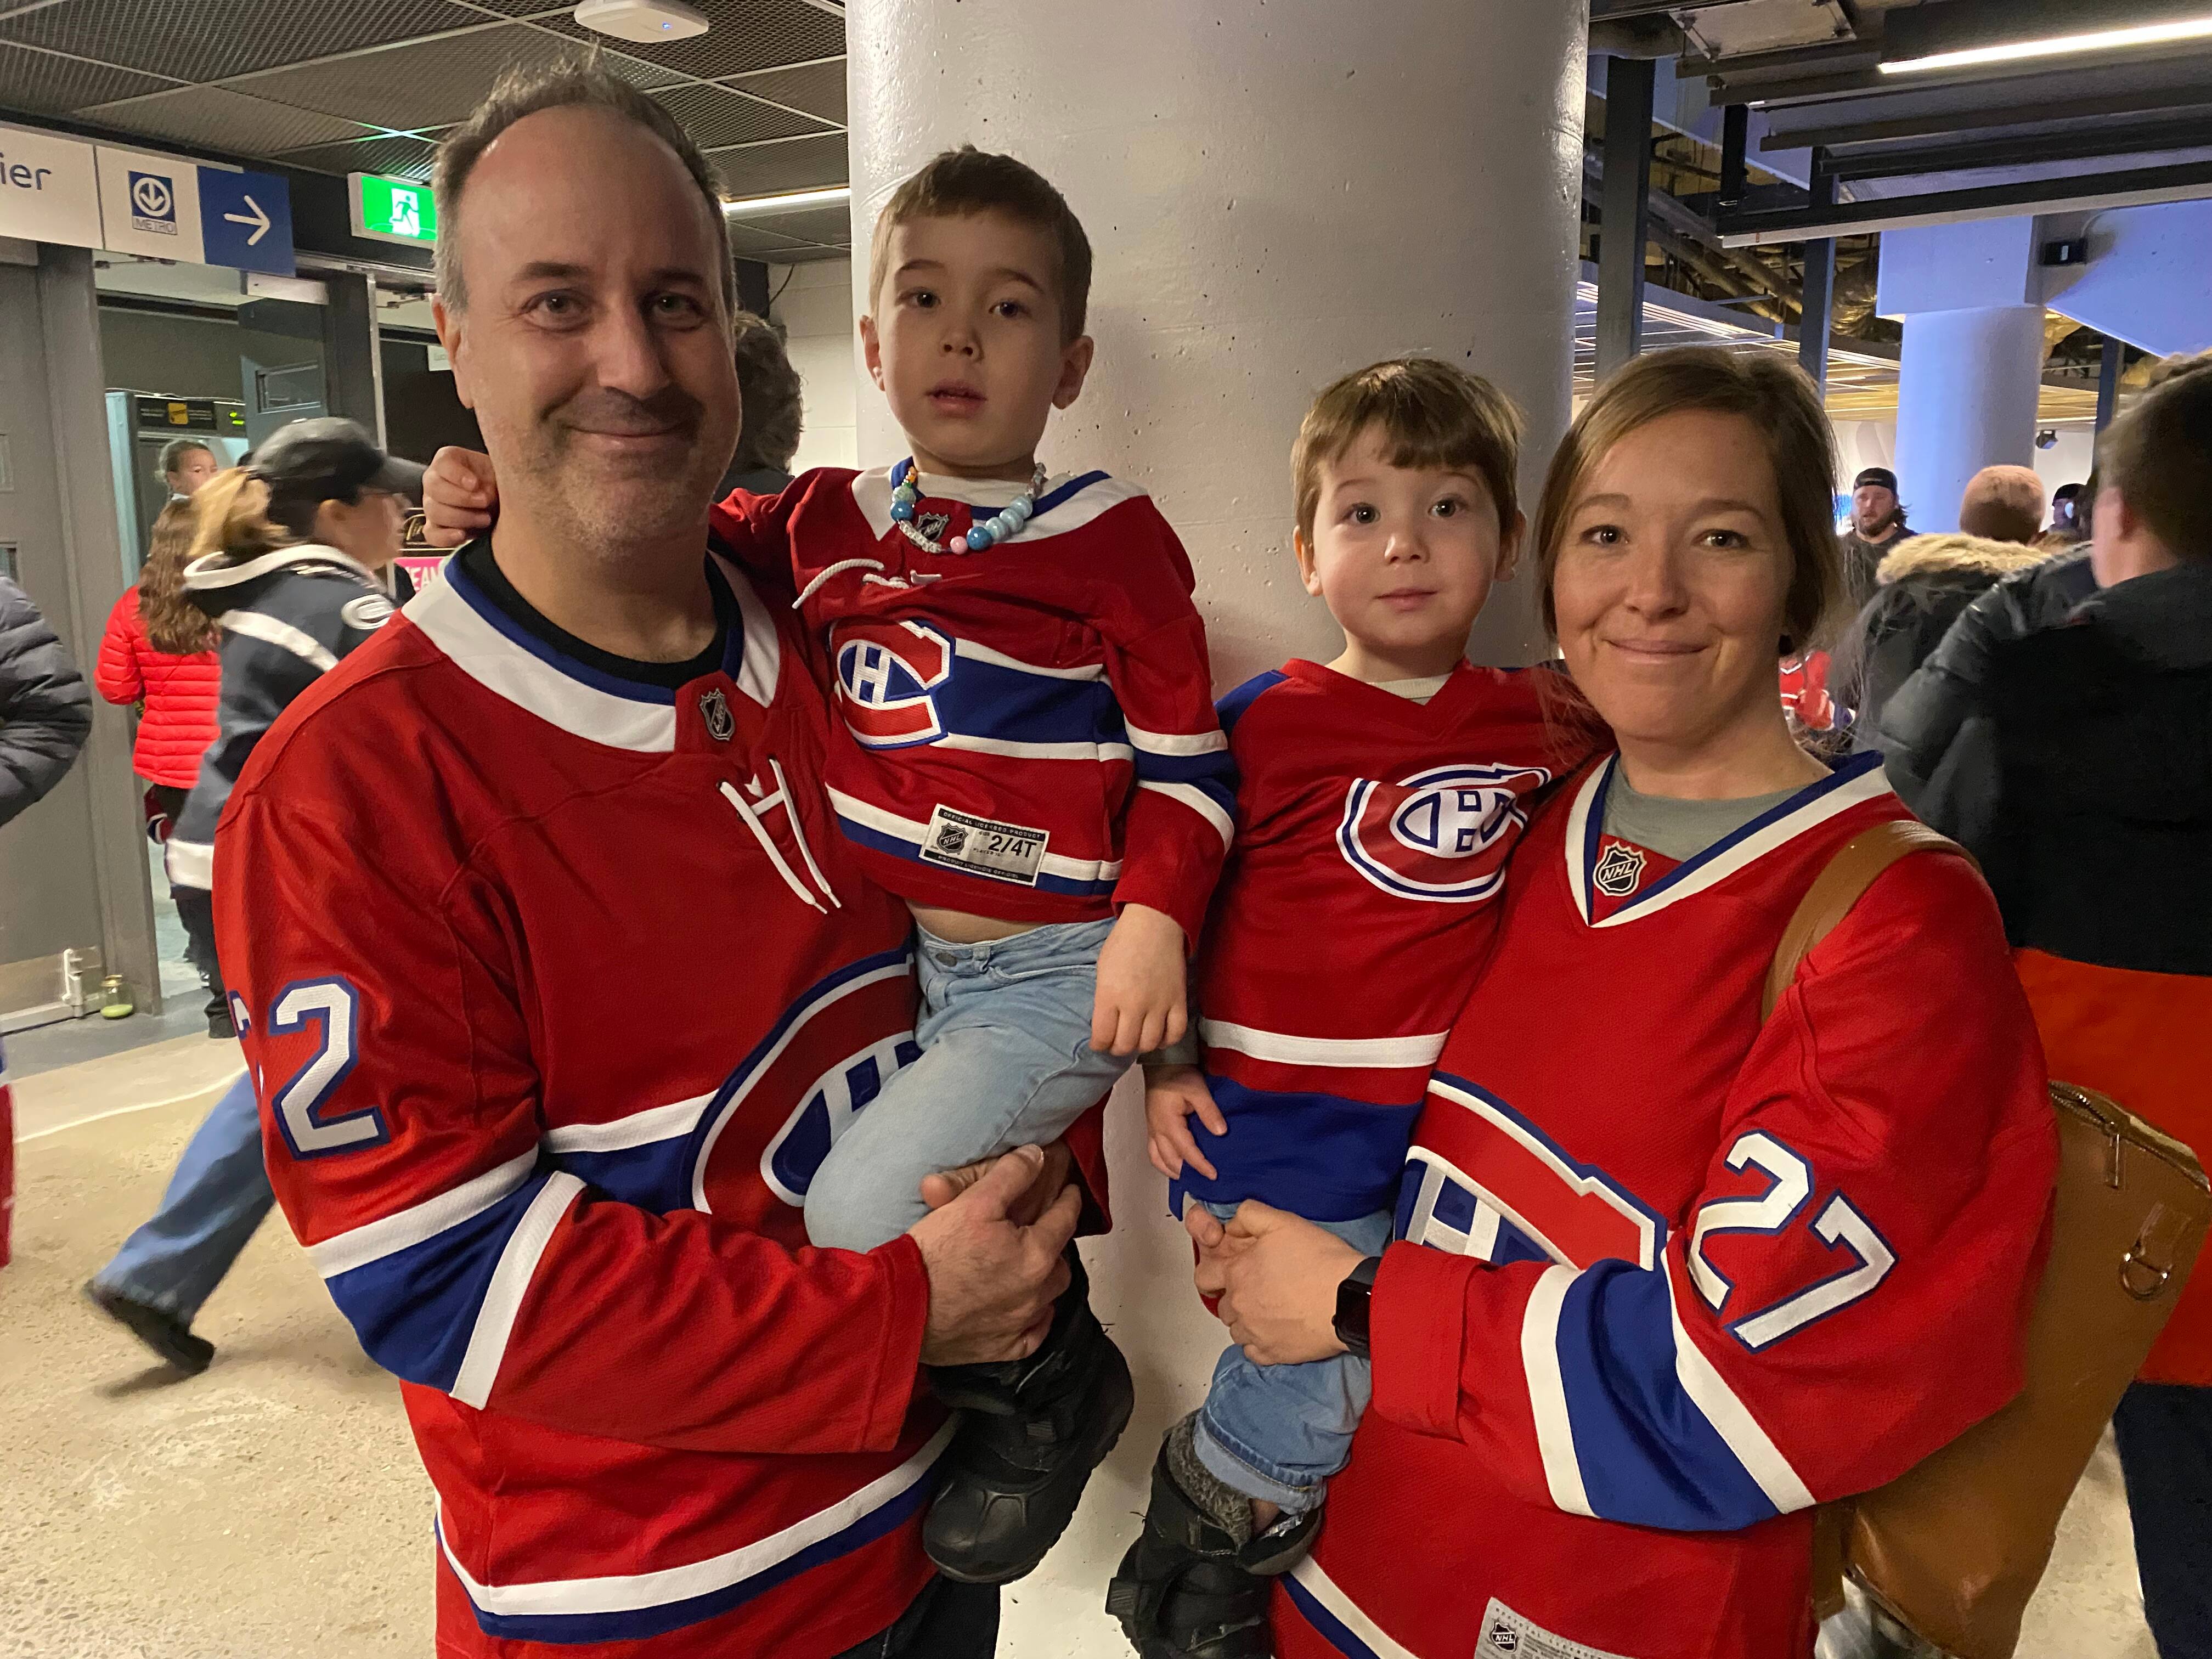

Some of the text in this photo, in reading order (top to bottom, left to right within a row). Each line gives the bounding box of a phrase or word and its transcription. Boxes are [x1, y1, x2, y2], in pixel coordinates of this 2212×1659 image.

[944, 835, 961, 845] NHL
[1010, 829, 1041, 838] PRODUCT
[988, 835, 1037, 857] 2/4T
[1602, 862, 1633, 881] NHL
[1686, 1128, 1900, 1354] 27
